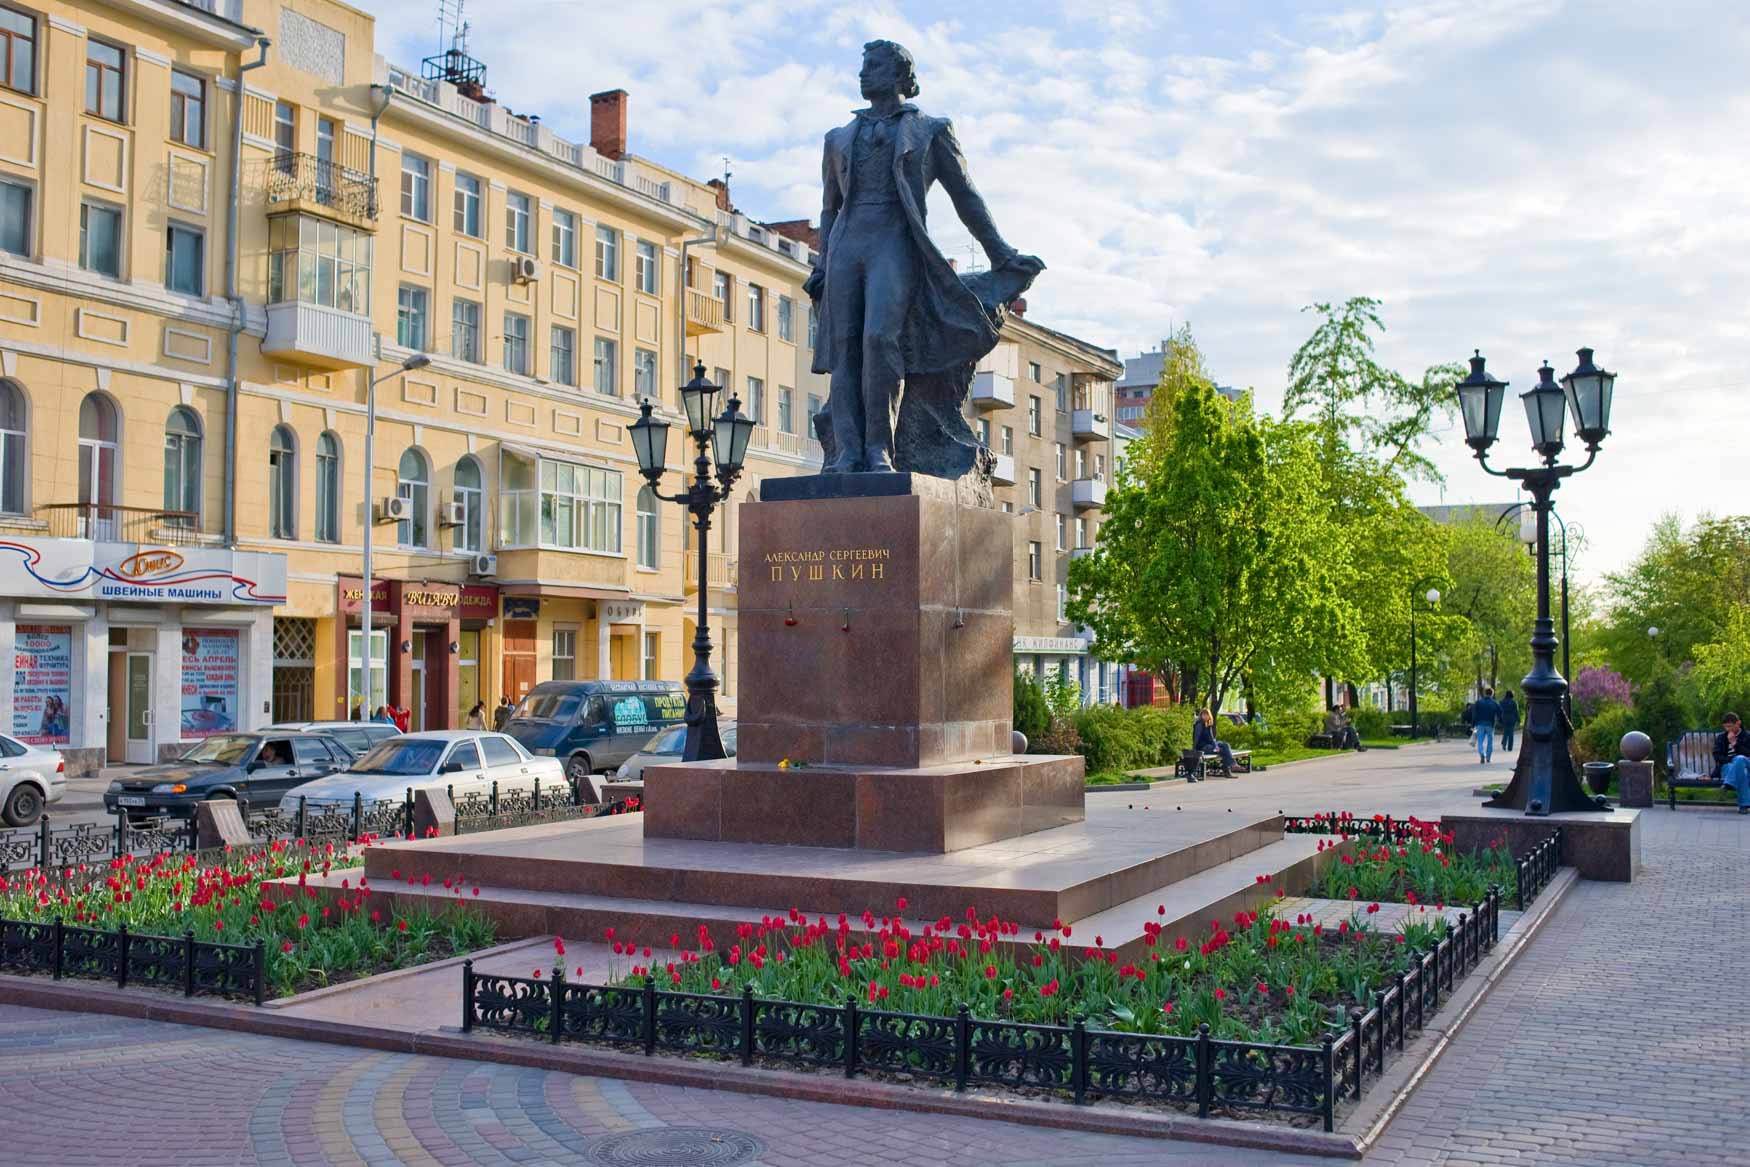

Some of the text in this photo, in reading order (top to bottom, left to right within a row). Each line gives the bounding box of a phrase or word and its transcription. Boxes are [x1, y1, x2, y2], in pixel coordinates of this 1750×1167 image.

[764, 549, 890, 562] АЛЕКСАНДР СЕРГЕЕВИЧ
[771, 563, 884, 581] ПУШКИН
[102, 585, 222, 599] ШВЕЙНЫЕ МАШИНЫ
[345, 589, 387, 601] ЖЕНКАЯ
